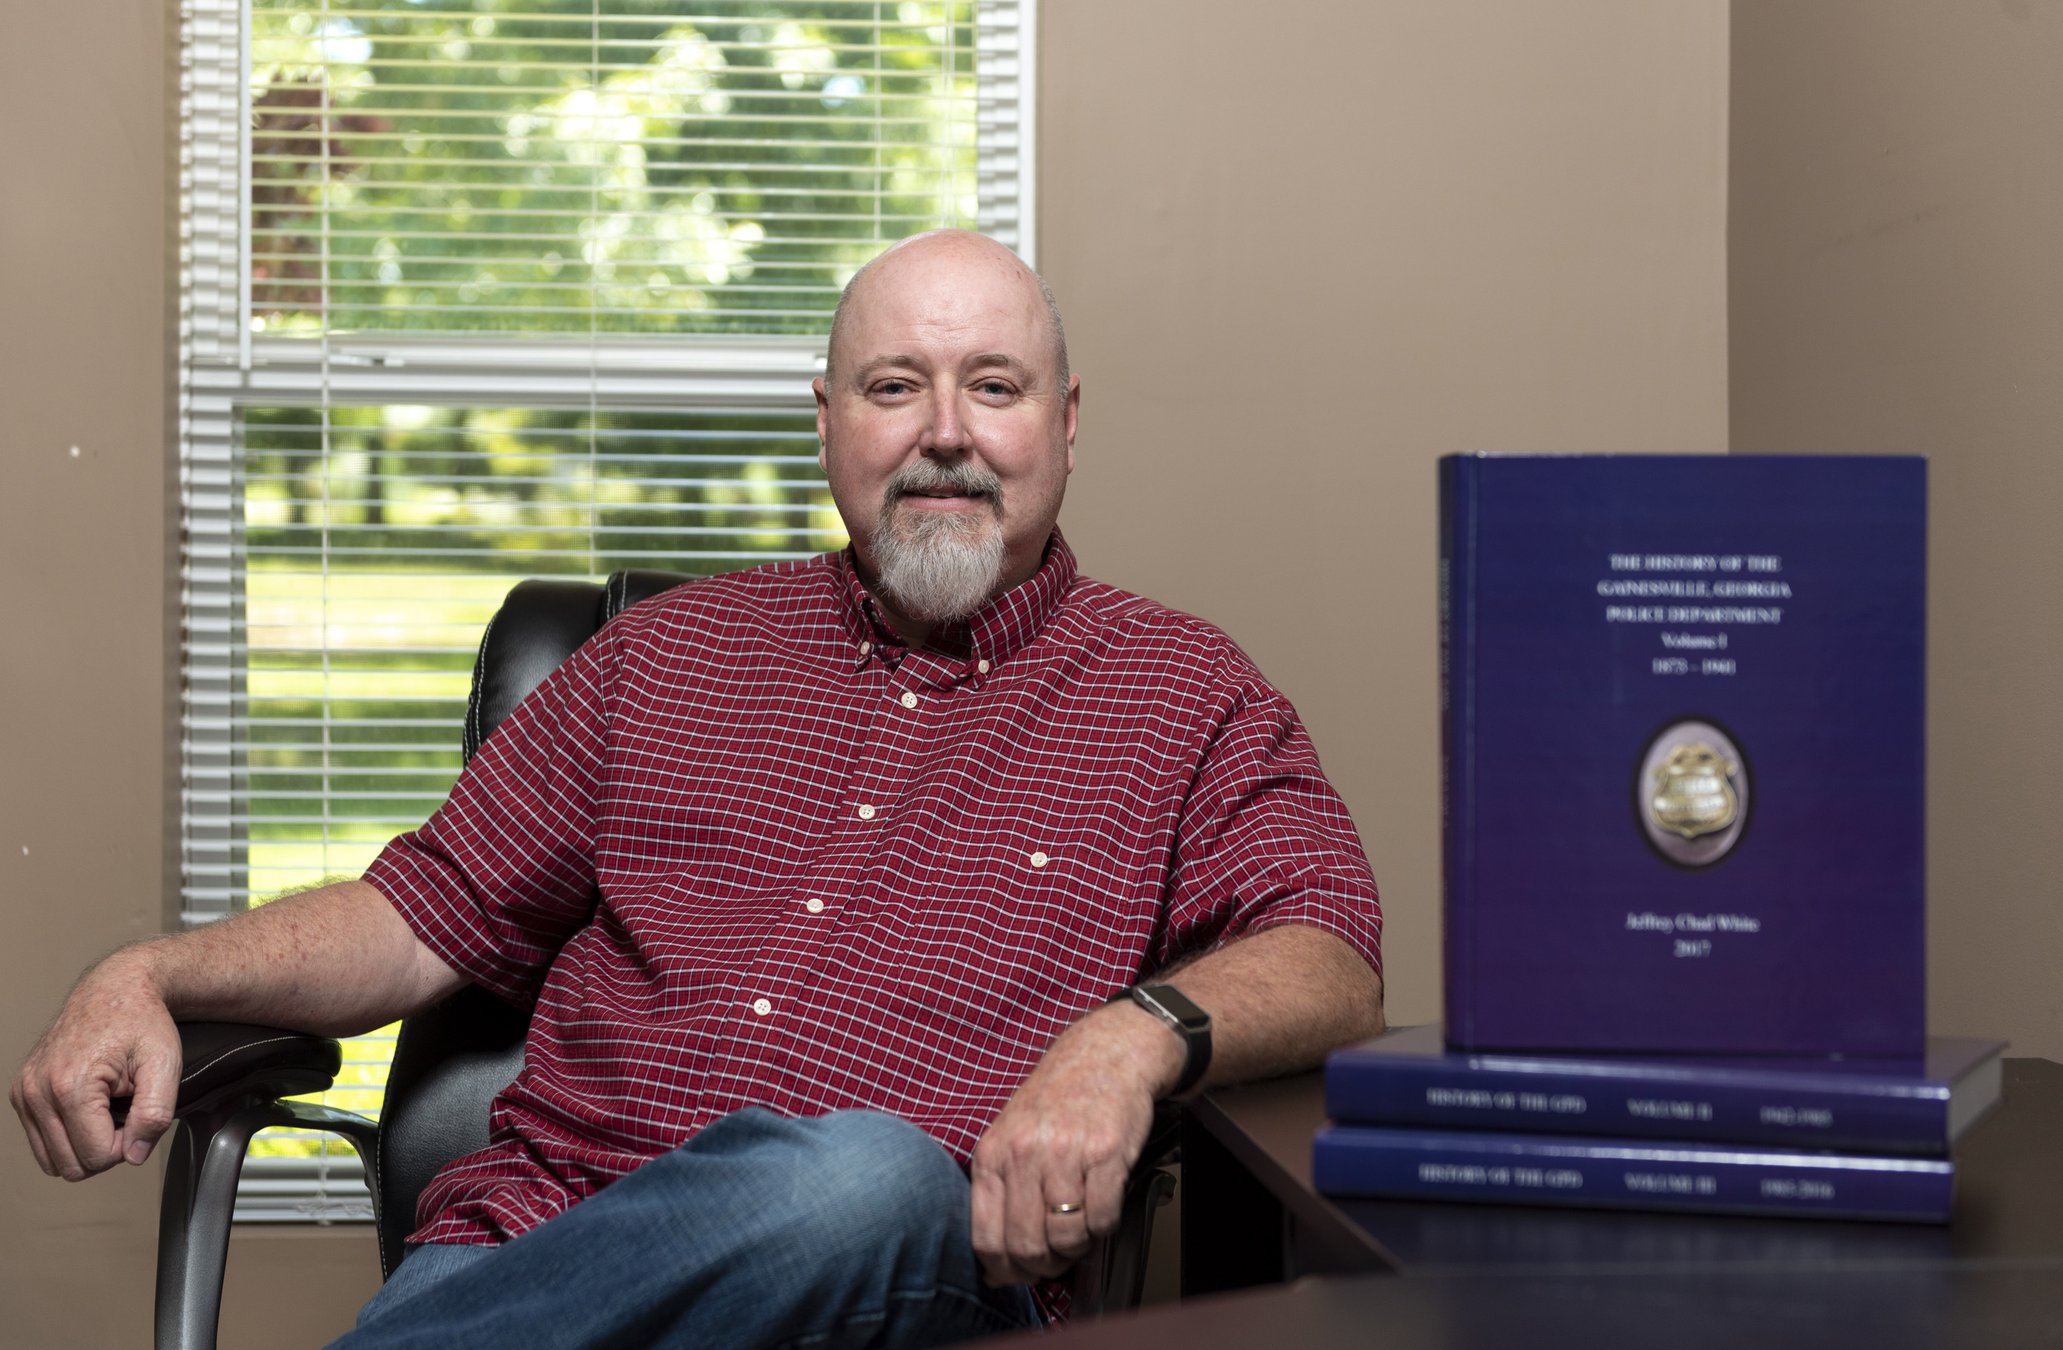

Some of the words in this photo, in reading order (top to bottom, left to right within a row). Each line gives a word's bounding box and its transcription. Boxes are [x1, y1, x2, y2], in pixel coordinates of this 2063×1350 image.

[1611, 553, 1641, 571] THE
[1645, 554, 1717, 571] HISTORY
[1720, 555, 1742, 571] OF
[1747, 555, 1782, 572] THE
[1713, 580, 1792, 598] GEORGIA
[1606, 605, 1664, 623] POLICE
[1668, 606, 1783, 624] DEPARTMENT
[1660, 631, 1717, 649] Volume
[1625, 912, 1674, 934] Jeffrey
[1675, 913, 1716, 931] Chad
[1716, 913, 1761, 933] White
[1673, 938, 1712, 957] 2017
[1426, 1087, 1493, 1109] HISTORY
[1493, 1091, 1515, 1110] OF
[1519, 1092, 1548, 1112] THE
[1549, 1094, 1587, 1115] GPD
[1627, 1098, 1694, 1120] VOLUME
[1418, 1163, 1487, 1185] HISTORY
[1487, 1166, 1510, 1186] OF
[1514, 1167, 1543, 1187] THE
[1544, 1168, 1583, 1189] GPD
[1624, 1171, 1693, 1193] VOLUME
